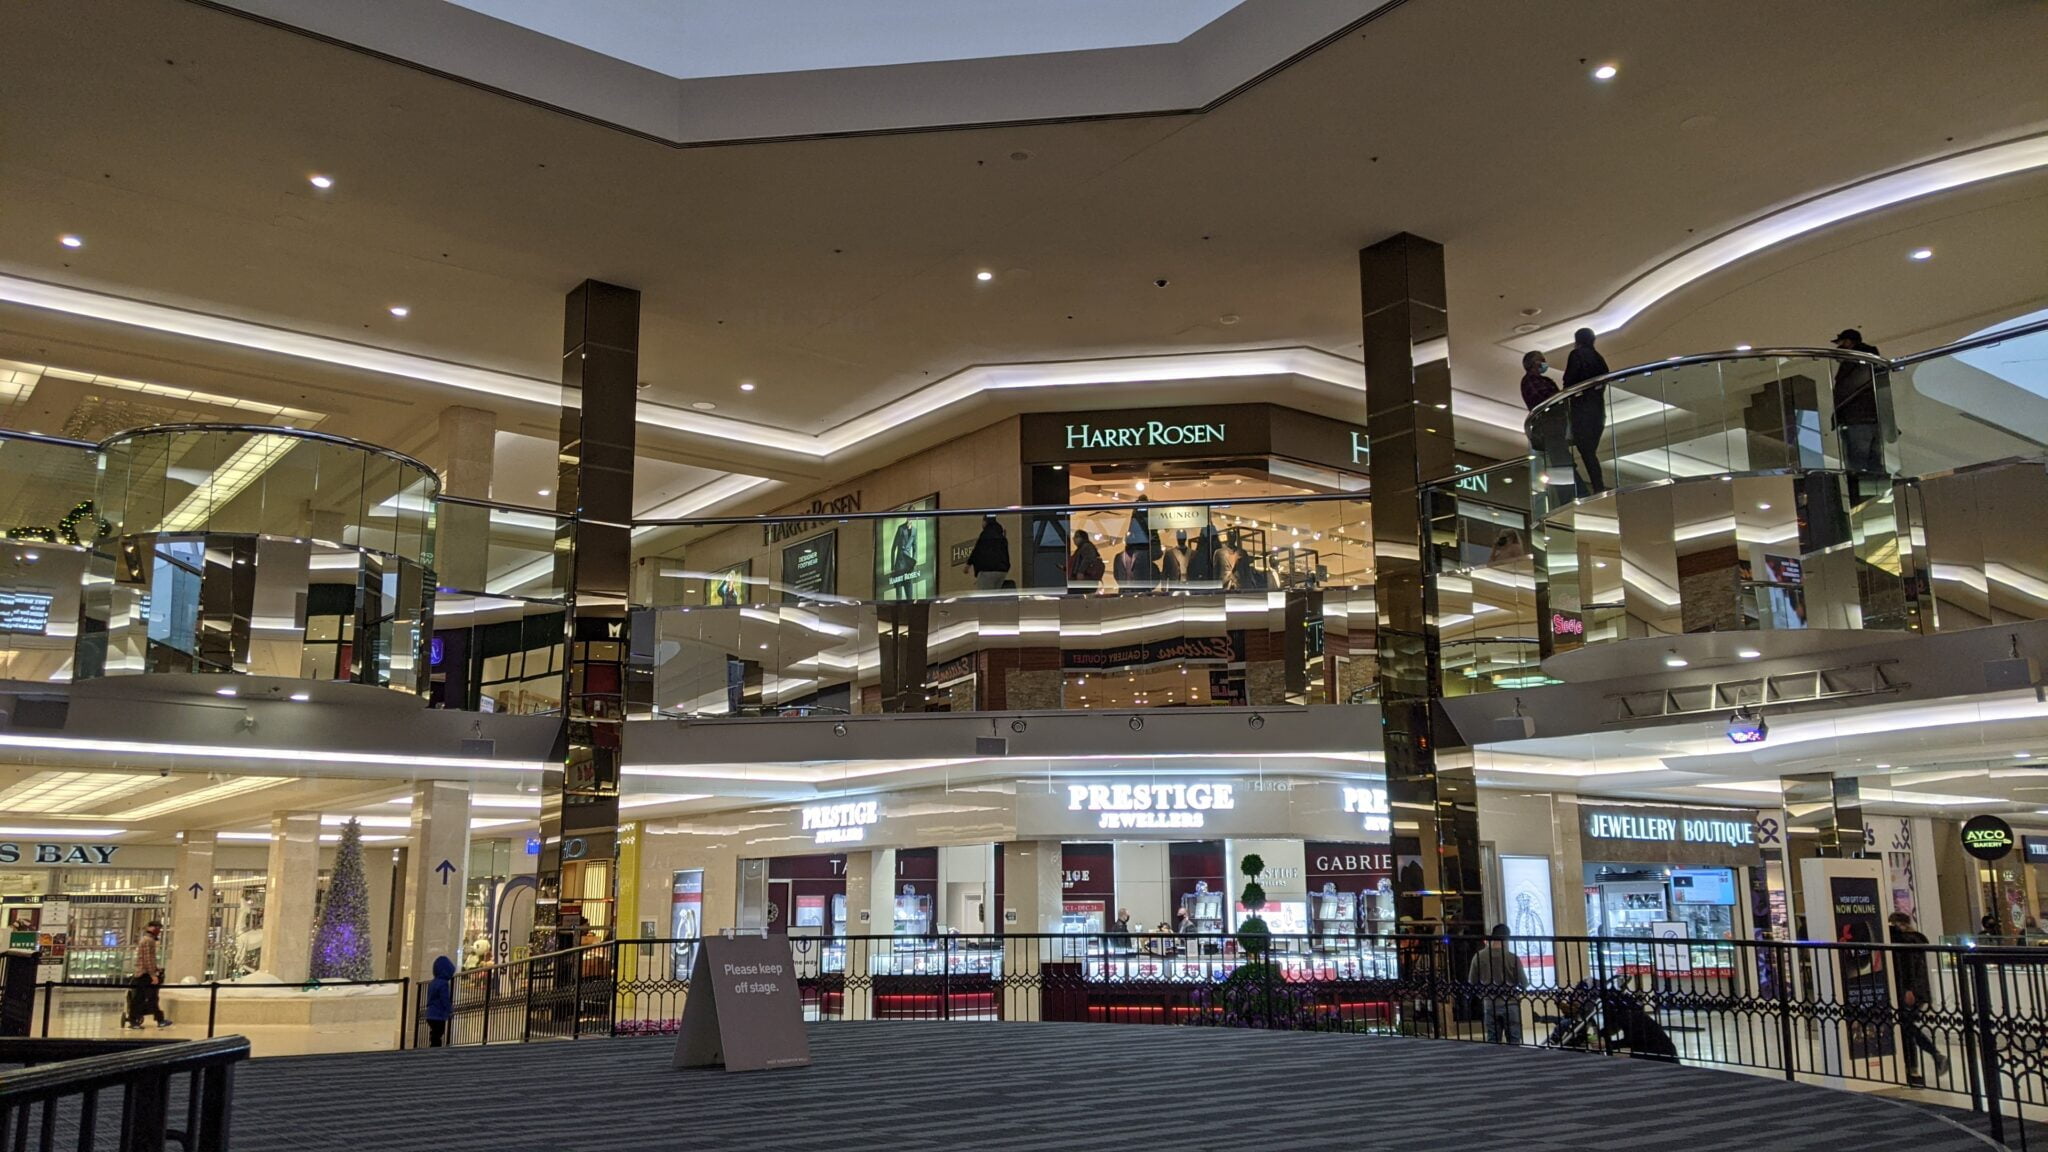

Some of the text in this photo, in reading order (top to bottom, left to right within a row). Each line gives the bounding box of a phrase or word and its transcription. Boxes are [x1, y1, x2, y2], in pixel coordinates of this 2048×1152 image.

[1066, 421, 1226, 449] HARRY ROSEN
[1158, 510, 1200, 520] MUNRO
[1067, 783, 1235, 811] PRESTIGE
[801, 801, 878, 830] PRESTIGE
[1098, 812, 1205, 829] JEWELLERS
[1591, 814, 1755, 848] JEWELLERY BOUTIQUE
[1966, 829, 2006, 841] AYCO
[34, 844, 120, 865] BAY
[1316, 854, 1392, 871] GABRIE
[1836, 904, 1876, 914] NOW ONLINE
[724, 963, 783, 976] Please keep
[735, 981, 780, 995] off stage.
